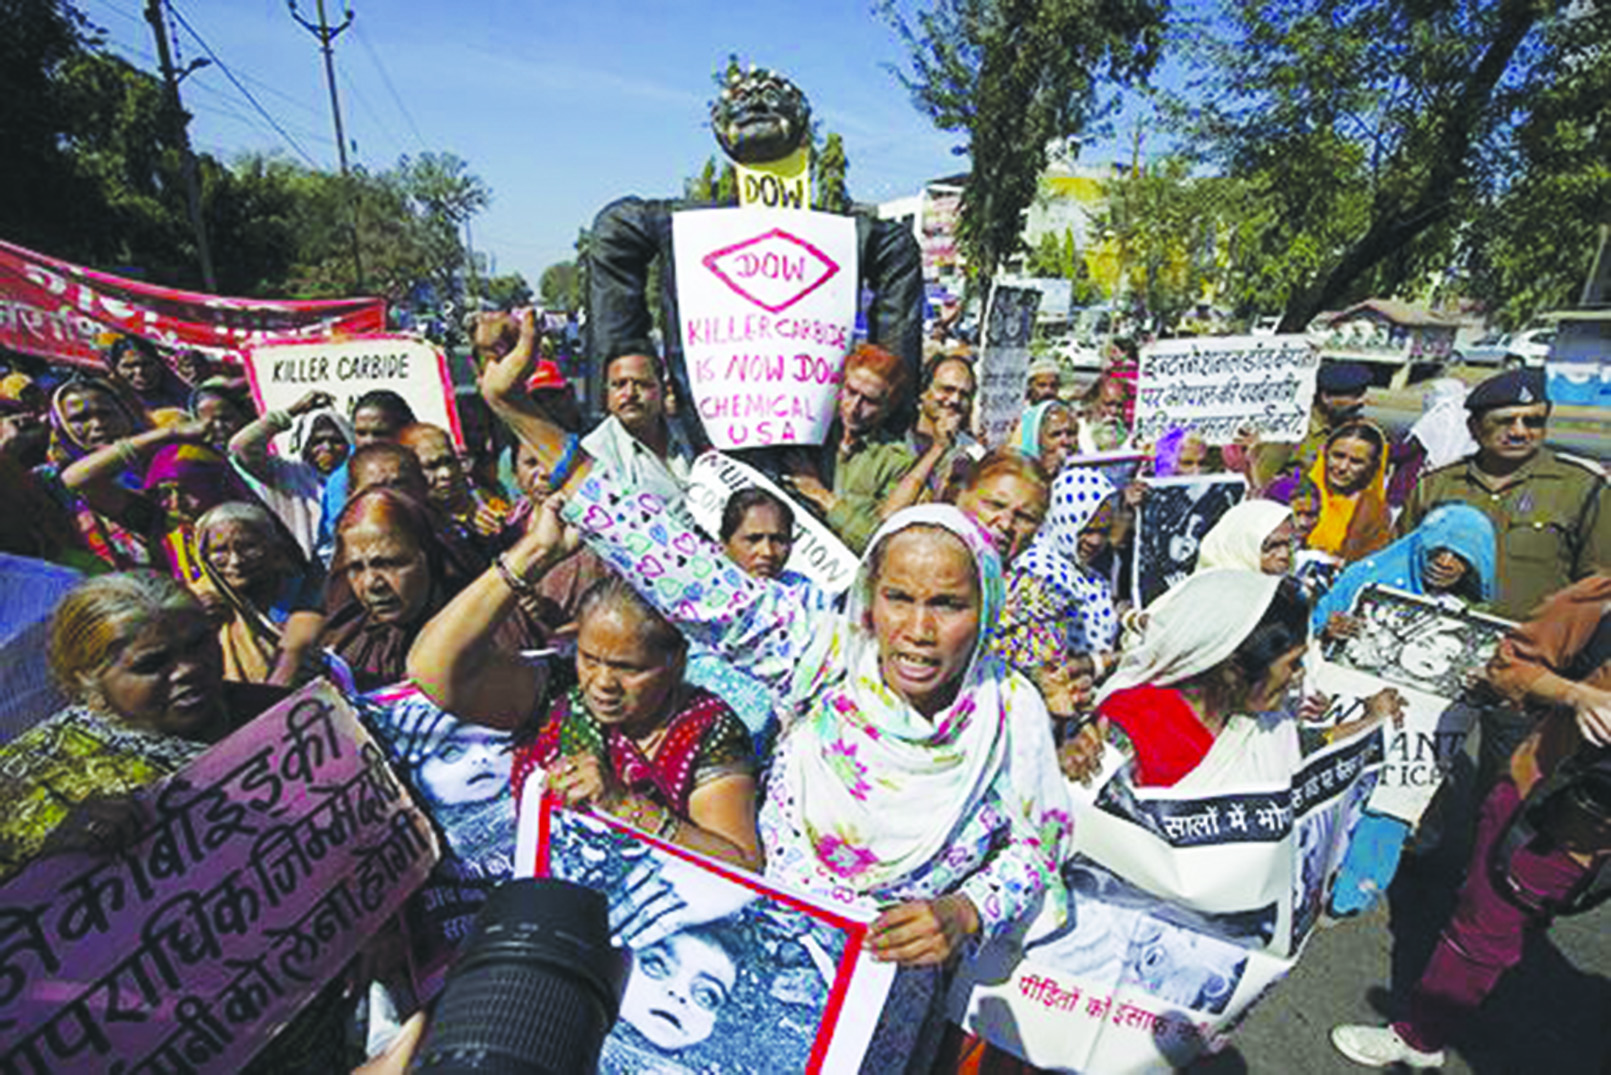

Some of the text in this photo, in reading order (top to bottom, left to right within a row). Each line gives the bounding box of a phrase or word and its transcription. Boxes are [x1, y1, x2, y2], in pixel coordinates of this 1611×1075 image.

[745, 175, 802, 209] DOW
[735, 252, 805, 281] DOW
[688, 314, 772, 346] KILLER
[272, 353, 410, 383] KILLER CARBIDE
[696, 360, 714, 384] IS
[724, 354, 785, 381] NOW
[699, 394, 816, 423] CHEMICAL
[728, 421, 796, 445] USA
[1389, 731, 1467, 762] ANT
[1226, 802, 1248, 832] में
